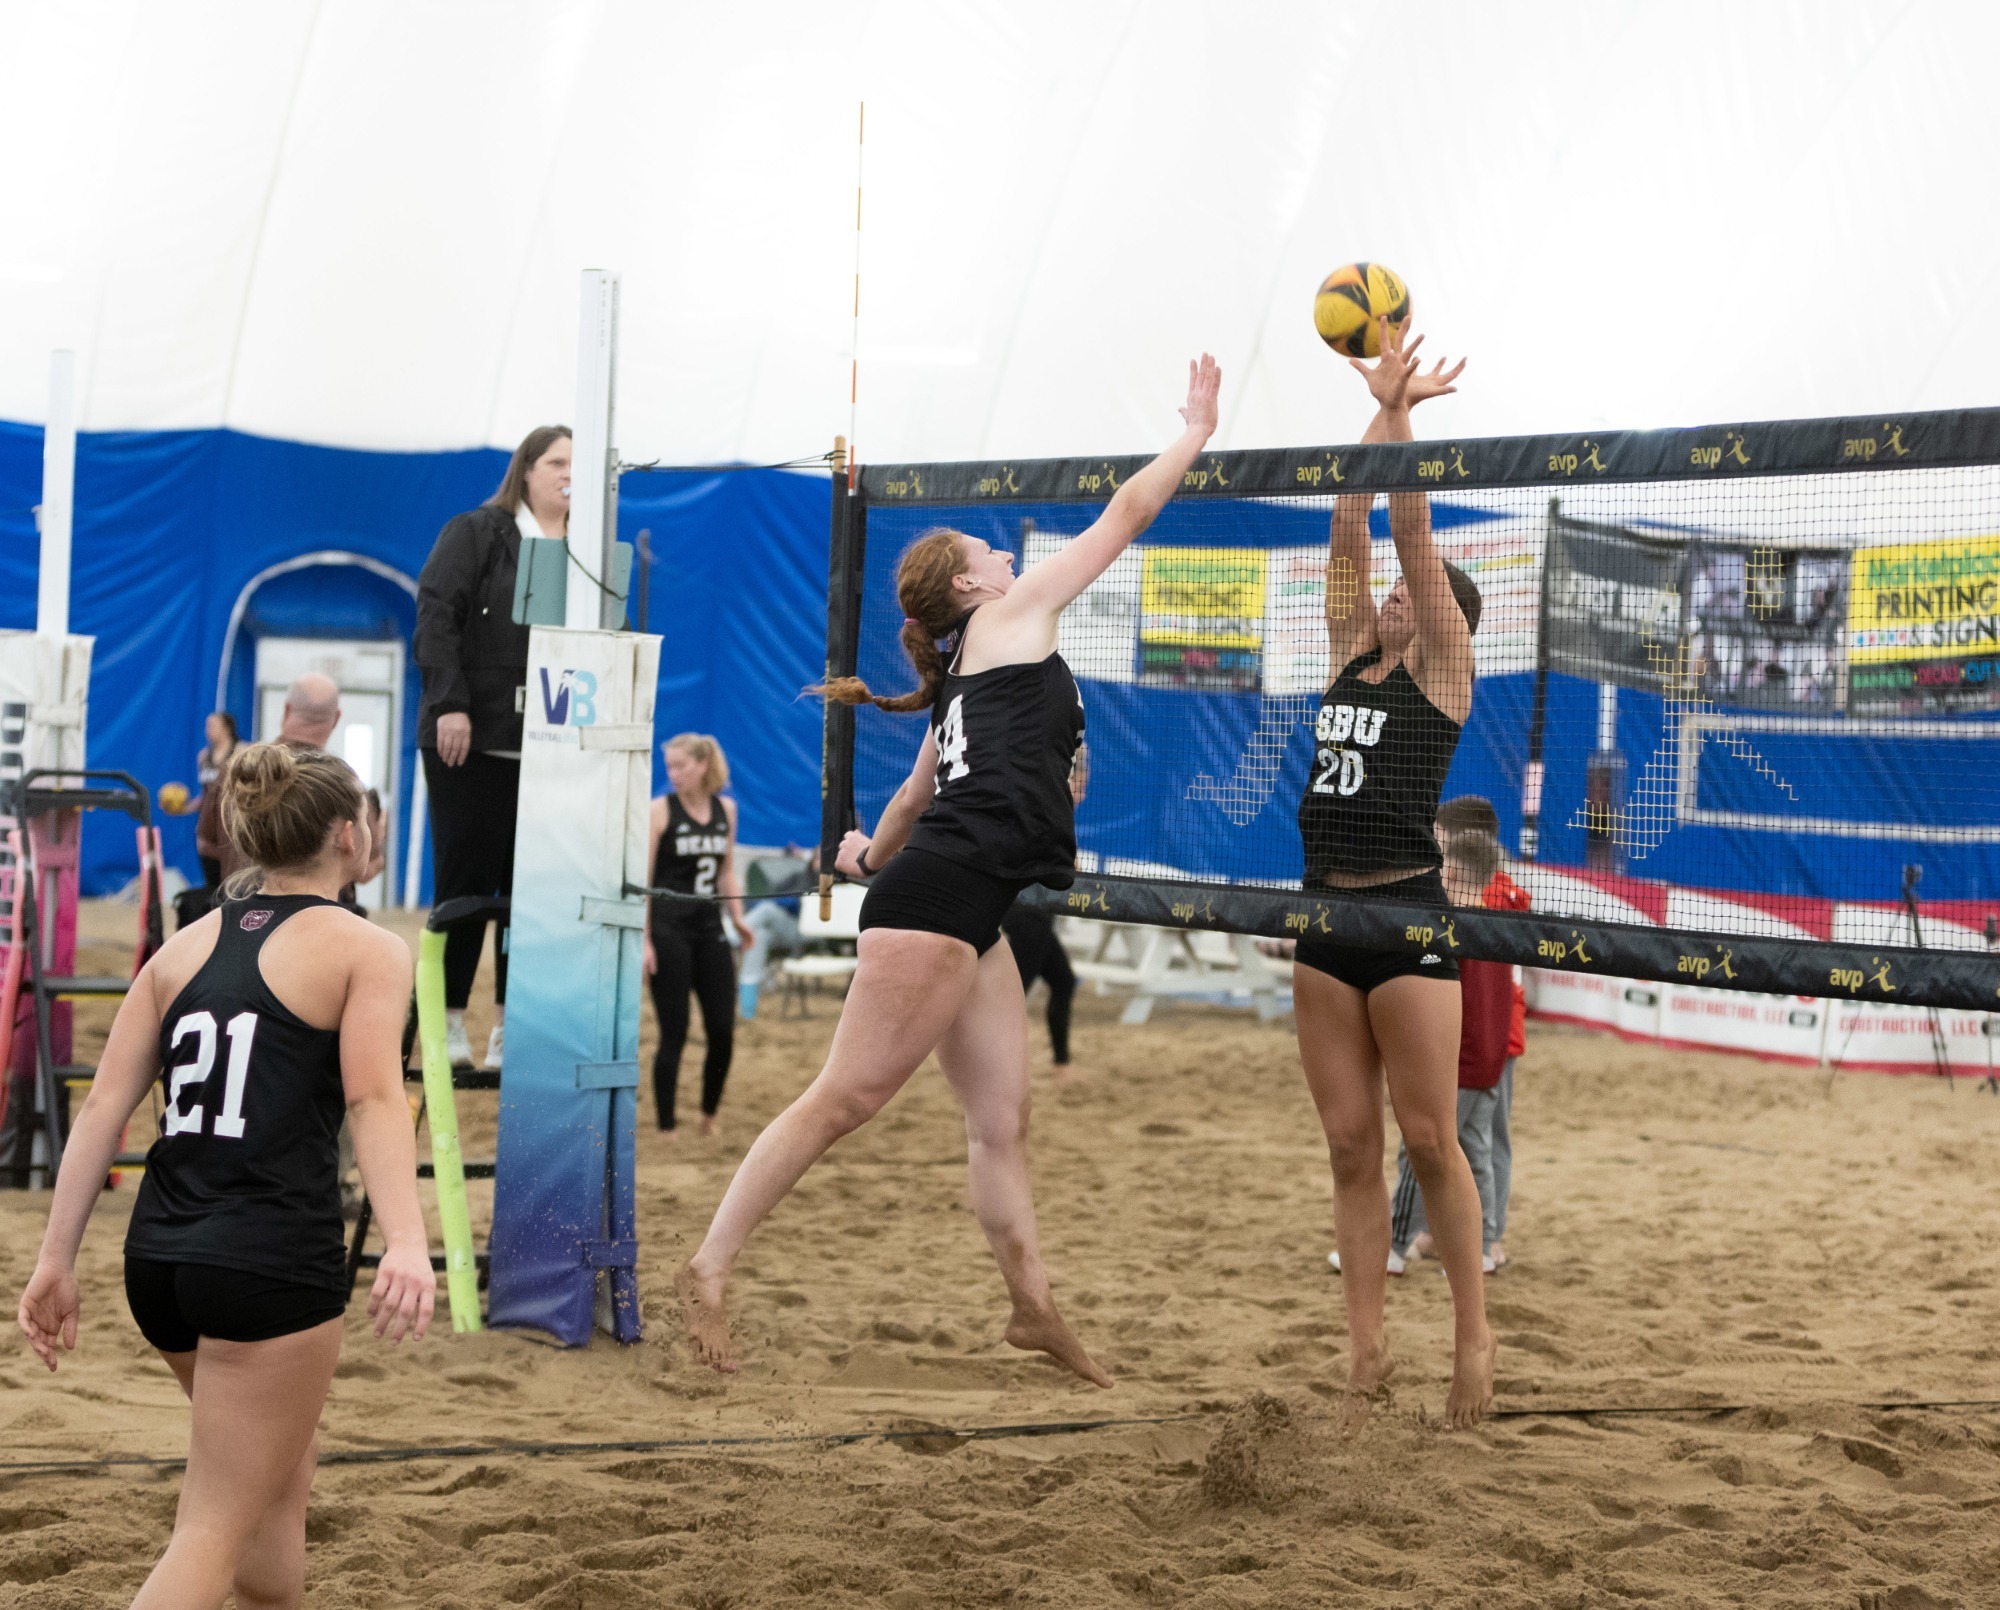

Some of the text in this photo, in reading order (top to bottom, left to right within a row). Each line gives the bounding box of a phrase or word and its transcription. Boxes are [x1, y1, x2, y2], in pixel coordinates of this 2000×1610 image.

[1691, 446, 1721, 469] avp
[1844, 437, 1877, 461] avp
[1296, 465, 1321, 486] avp
[1418, 460, 1444, 481] avp
[1549, 453, 1577, 476] avp
[886, 481, 907, 497] avp
[979, 477, 999, 496] avp
[1078, 474, 1100, 493] avp
[1184, 470, 1207, 490] avp
[1876, 581, 1997, 620] PRINTING
[540, 667, 597, 727] VB
[1315, 705, 1387, 746] SBU
[1313, 748, 1364, 796] 20
[694, 857, 717, 896] 2
[1068, 891, 1090, 912] avp
[1171, 902, 1194, 923] avp
[1285, 912, 1309, 934] avp
[1406, 924, 1433, 947] avp
[1538, 938, 1566, 963] avp
[1677, 954, 1710, 979] avp
[1830, 968, 1863, 993] avp
[165, 1011, 258, 1138] 21
